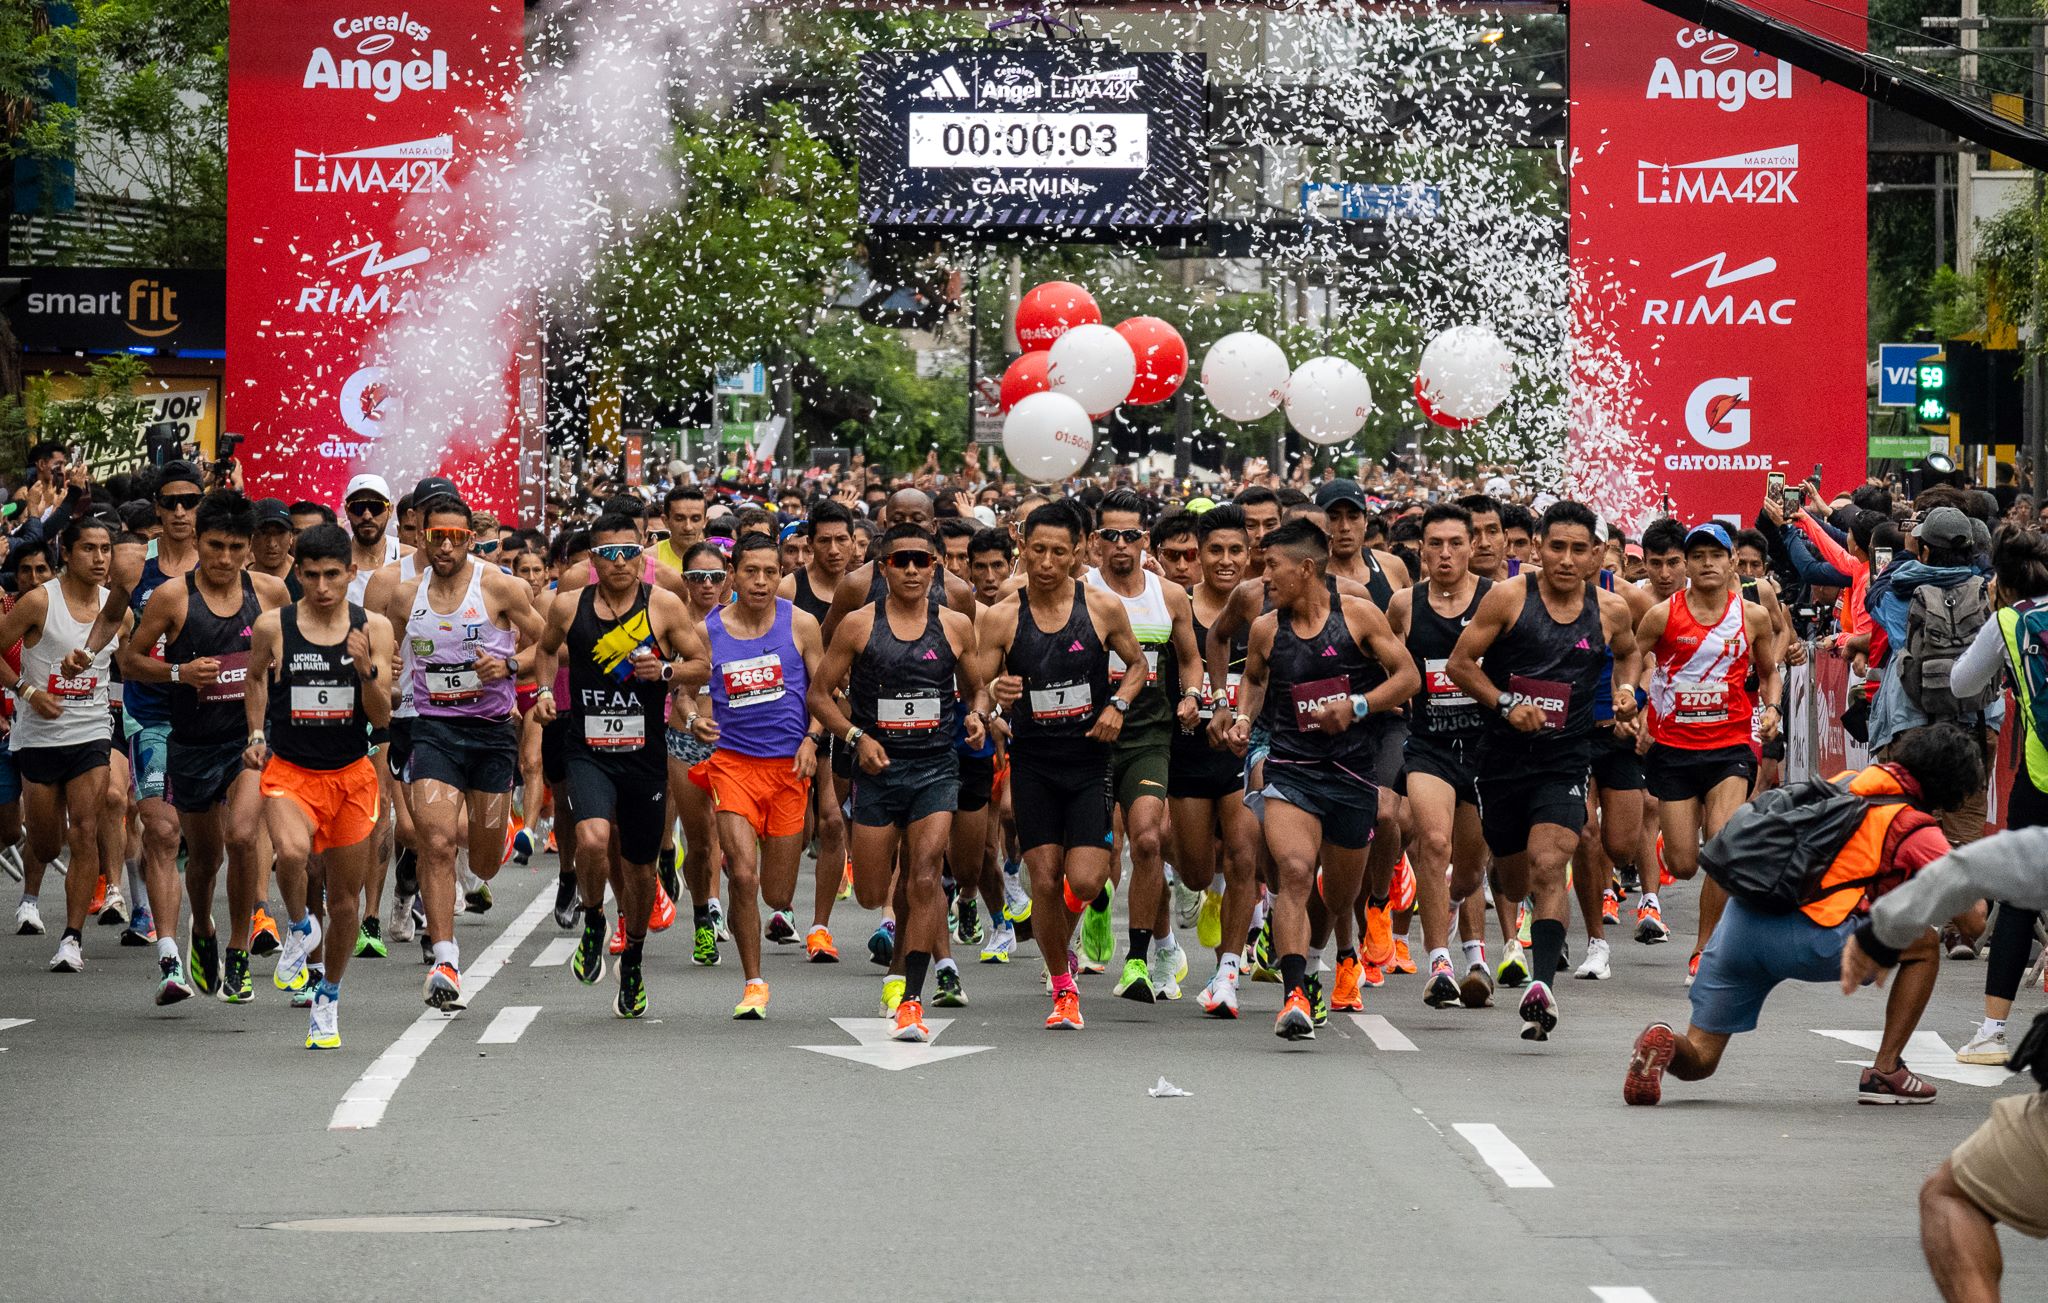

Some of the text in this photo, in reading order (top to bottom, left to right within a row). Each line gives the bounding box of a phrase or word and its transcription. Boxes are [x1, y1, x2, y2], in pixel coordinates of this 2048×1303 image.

[333, 12, 431, 41] Cereales
[303, 47, 447, 103] Angel
[1646, 57, 1792, 112] Angel
[981, 80, 1042, 104] Angel
[943, 124, 1117, 156] 00:00:03
[1744, 156, 1795, 165] MARATÓN
[972, 177, 1079, 196] GARMIN
[27, 279, 178, 321] smart fit
[1641, 295, 1797, 325] RIMAC
[1884, 366, 1917, 385] VIS
[1920, 366, 1944, 388] 59
[1664, 455, 1772, 470] GATORADE
[289, 662, 303, 671] SAN
[293, 653, 323, 662] UCHIZA
[54, 677, 92, 690] 2682
[444, 675, 462, 689] 16
[730, 667, 775, 687] 2666
[318, 690, 328, 705] 6
[581, 689, 642, 708] FF.AA
[1056, 691, 1065, 704] 7
[1512, 692, 1565, 712] PACER
[1681, 693, 1723, 706] 2704
[904, 702, 915, 716] 8
[603, 719, 624, 732] 70
